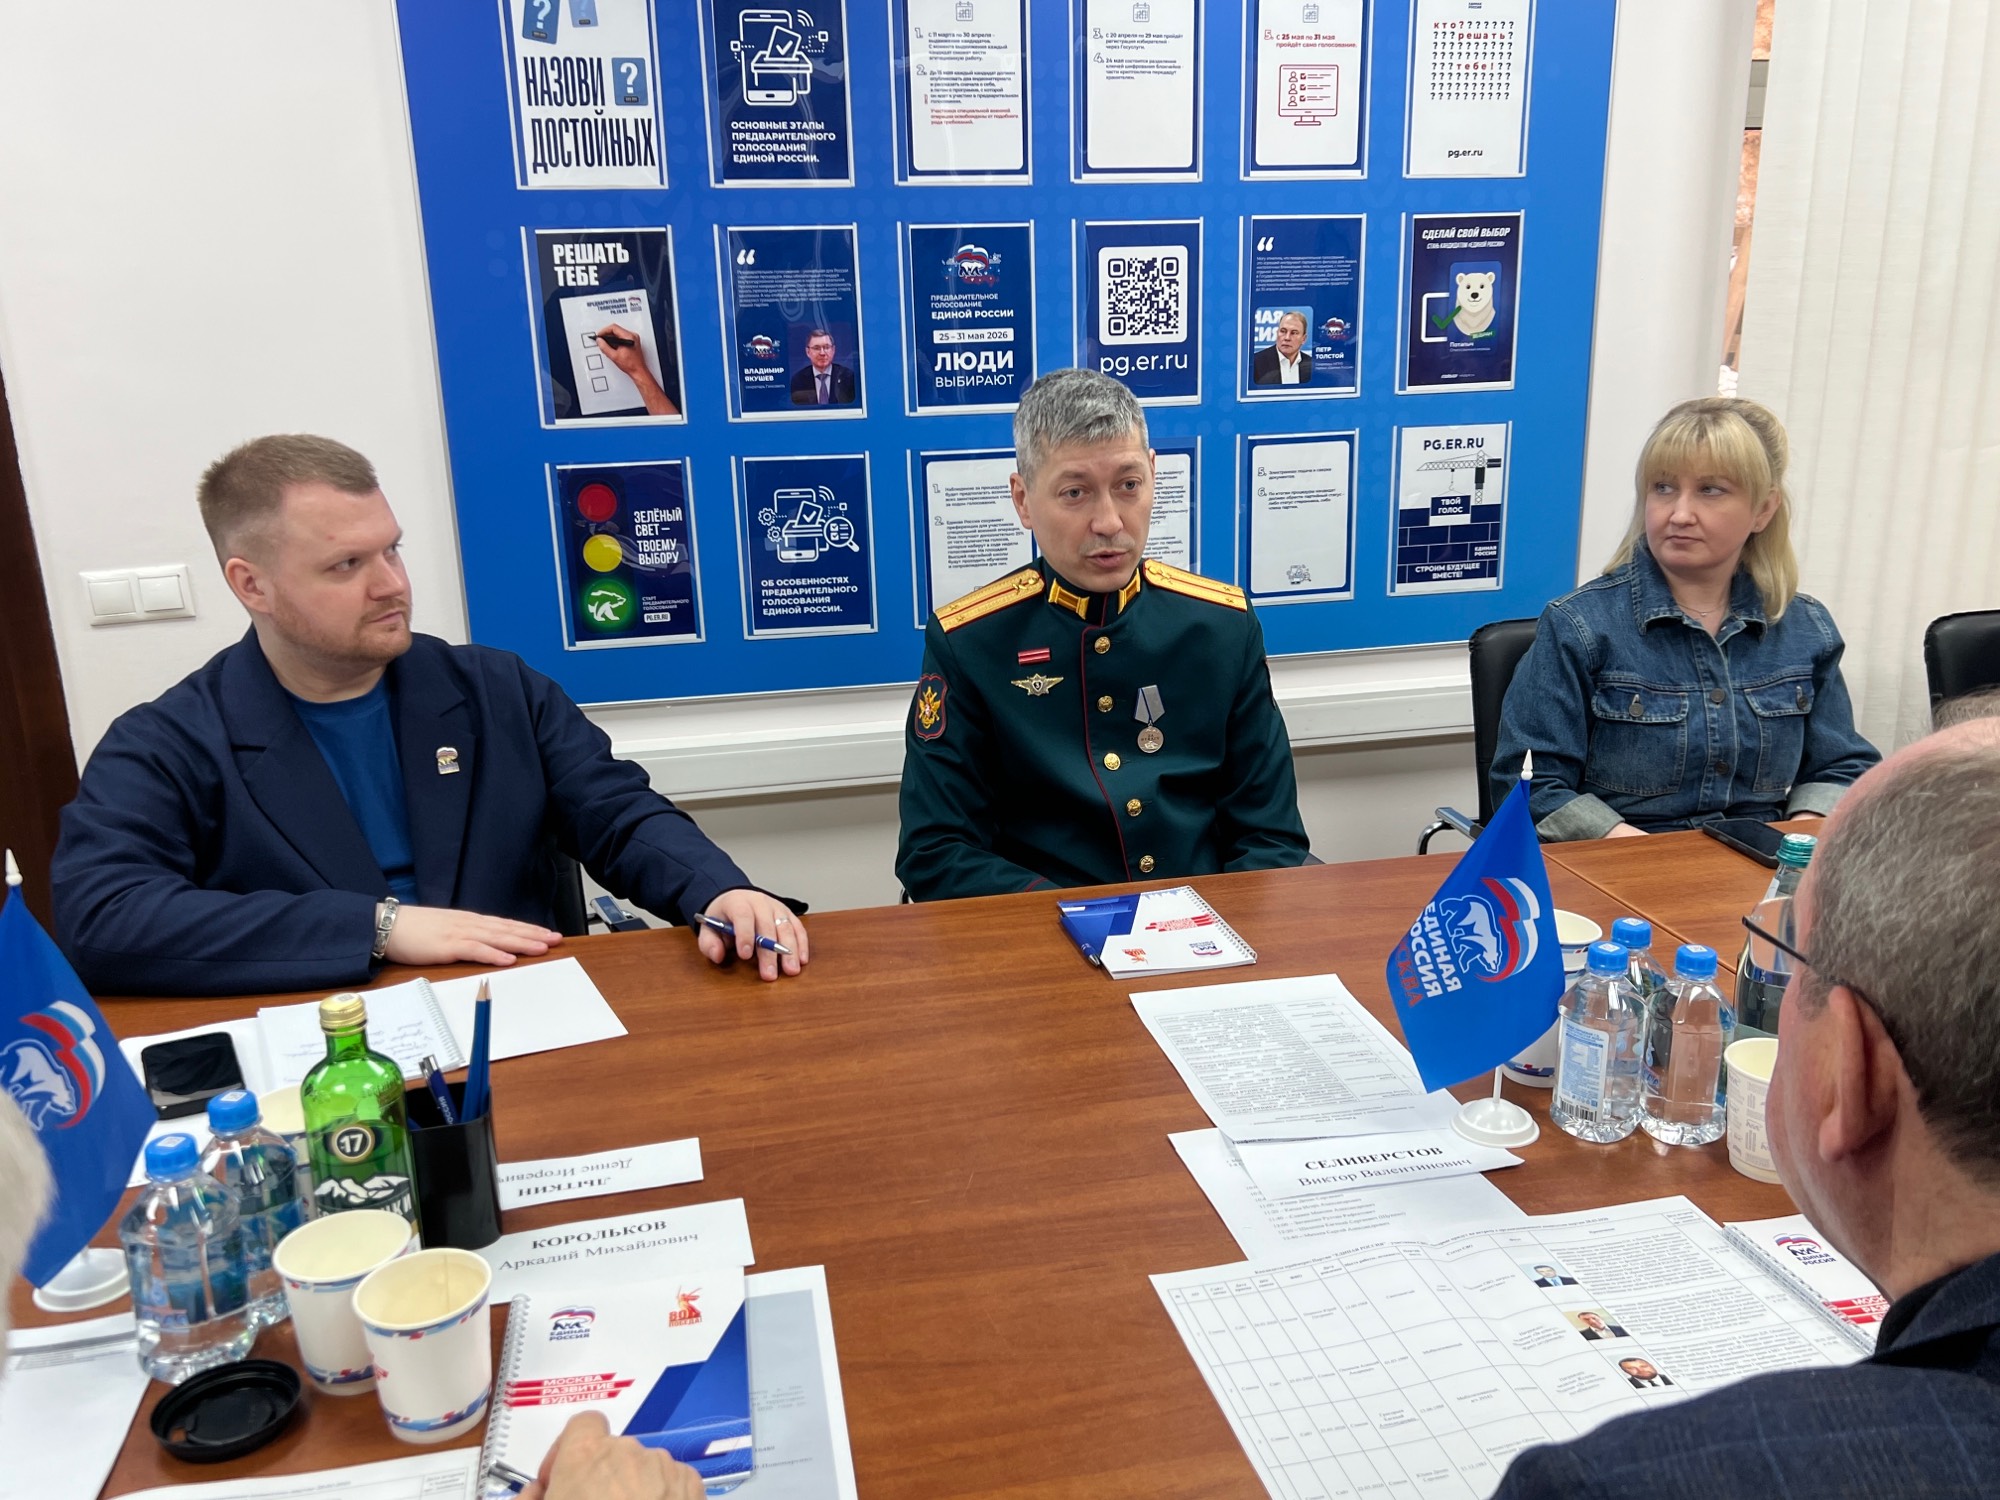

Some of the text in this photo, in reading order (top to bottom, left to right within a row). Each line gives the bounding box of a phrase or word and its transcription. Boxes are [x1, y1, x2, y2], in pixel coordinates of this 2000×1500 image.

[1264, 30, 1274, 40] 5.
[523, 56, 605, 107] НАЗОВИ
[731, 121, 825, 130] ОСНОВНЫЕ ЭТАПЫ
[531, 109, 656, 174] ДОСТОЙНЫХ
[732, 132, 836, 142] ПРЕДВАРИТЕЛЬНОГО
[733, 143, 806, 152] ГОЛОСОВАНИЯ
[1448, 148, 1483, 158] pg.er.ru
[734, 153, 820, 164] ЕДИНОЙ РОССИИ.
[1422, 226, 1510, 240] СДЕЛАЙ СВОЙ ВЫБОР
[553, 243, 629, 264] РЕШАТЬ
[554, 265, 599, 286] ТЕБЕ
[931, 293, 998, 302] ПРЕДВАРИТЕЛЬНОЕ
[931, 309, 1014, 320] ЕДИНОЙ РОССИИ
[987, 331, 1008, 339] 2026
[934, 350, 1014, 372] ЛЮДИ
[1100, 354, 1188, 376] pg.er.ru
[935, 374, 1014, 387] ВЫБИРАЮТ
[1424, 438, 1484, 450] PG.ER.RU
[634, 507, 682, 523] ЗЕЛЁНЫЙ
[635, 524, 660, 536] СВЕТ
[637, 539, 677, 552] ТВОЕМУ
[638, 552, 679, 565] ВЫБОРУ
[1415, 562, 1480, 573] СТРОИМ БУДУЩЕЕ
[776, 576, 849, 586] ОСОБЕННОСТЯХ
[762, 586, 858, 597] ПРЕДВАРИТЕЛЬНОГО
[763, 596, 831, 606] ГОЛОСОВАНИЯ
[763, 605, 802, 616] ЕДИНОЙ
[1423, 901, 1462, 992] ЕДИНАЯ
[1410, 910, 1443, 998] ОССИЯ
[340, 1134, 363, 1153] 17
[582, 1158, 632, 1173] Денис
[1304, 1147, 1443, 1171] СЕЛИВЕРСТОВ
[1298, 1159, 1472, 1187] Виктор Валентинович
[518, 1178, 612, 1197] ЛЫТКИН
[531, 1221, 667, 1250] КОРОЛЬКОВ
[499, 1233, 699, 1271] Аркадий Михайлович
[1797, 1253, 1831, 1262] ЕДИНАЯ
[549, 1333, 590, 1341] РОССИЯ
[550, 1328, 590, 1336] ЕДИНАЯ
[543, 1375, 603, 1386] МОСКВА
[541, 1381, 615, 1395] РАЗВИТИЕ
[540, 1391, 609, 1405] БУДУЩЕЕ
